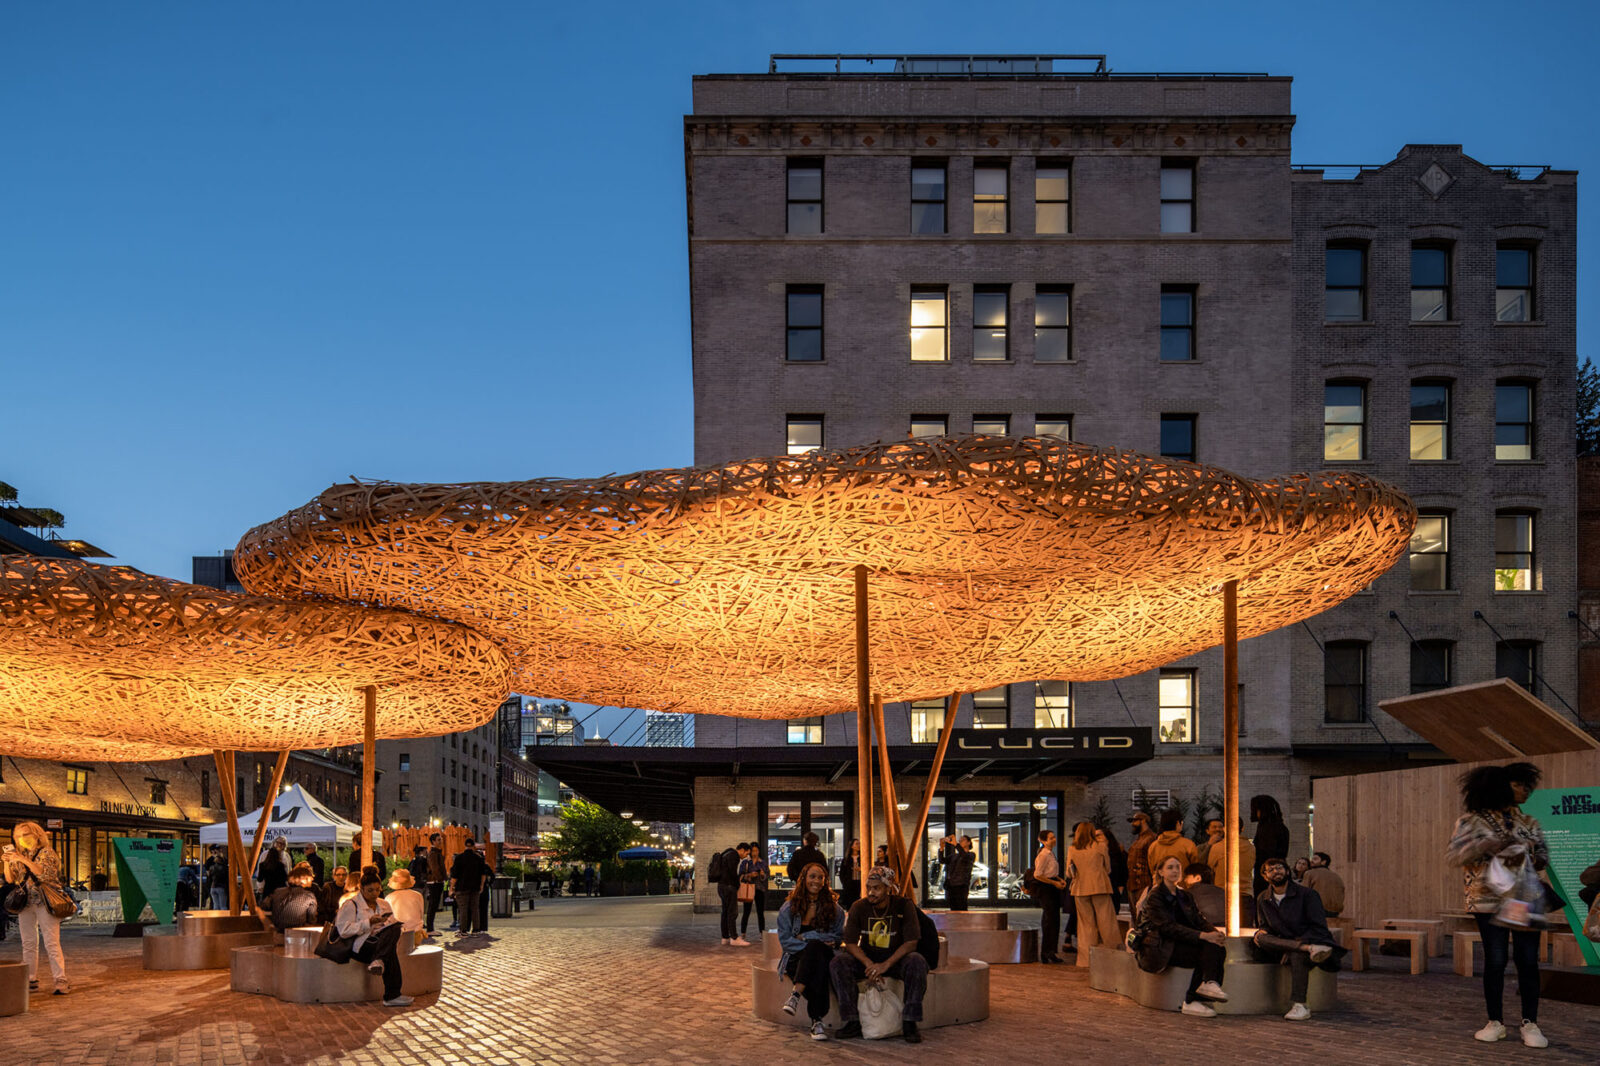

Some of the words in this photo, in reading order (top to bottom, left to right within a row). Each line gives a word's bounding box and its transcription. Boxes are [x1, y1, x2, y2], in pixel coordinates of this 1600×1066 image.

[958, 736, 1133, 749] LUCID
[1562, 795, 1592, 805] NYC
[113, 802, 133, 816] NEW
[135, 805, 157, 818] YORK
